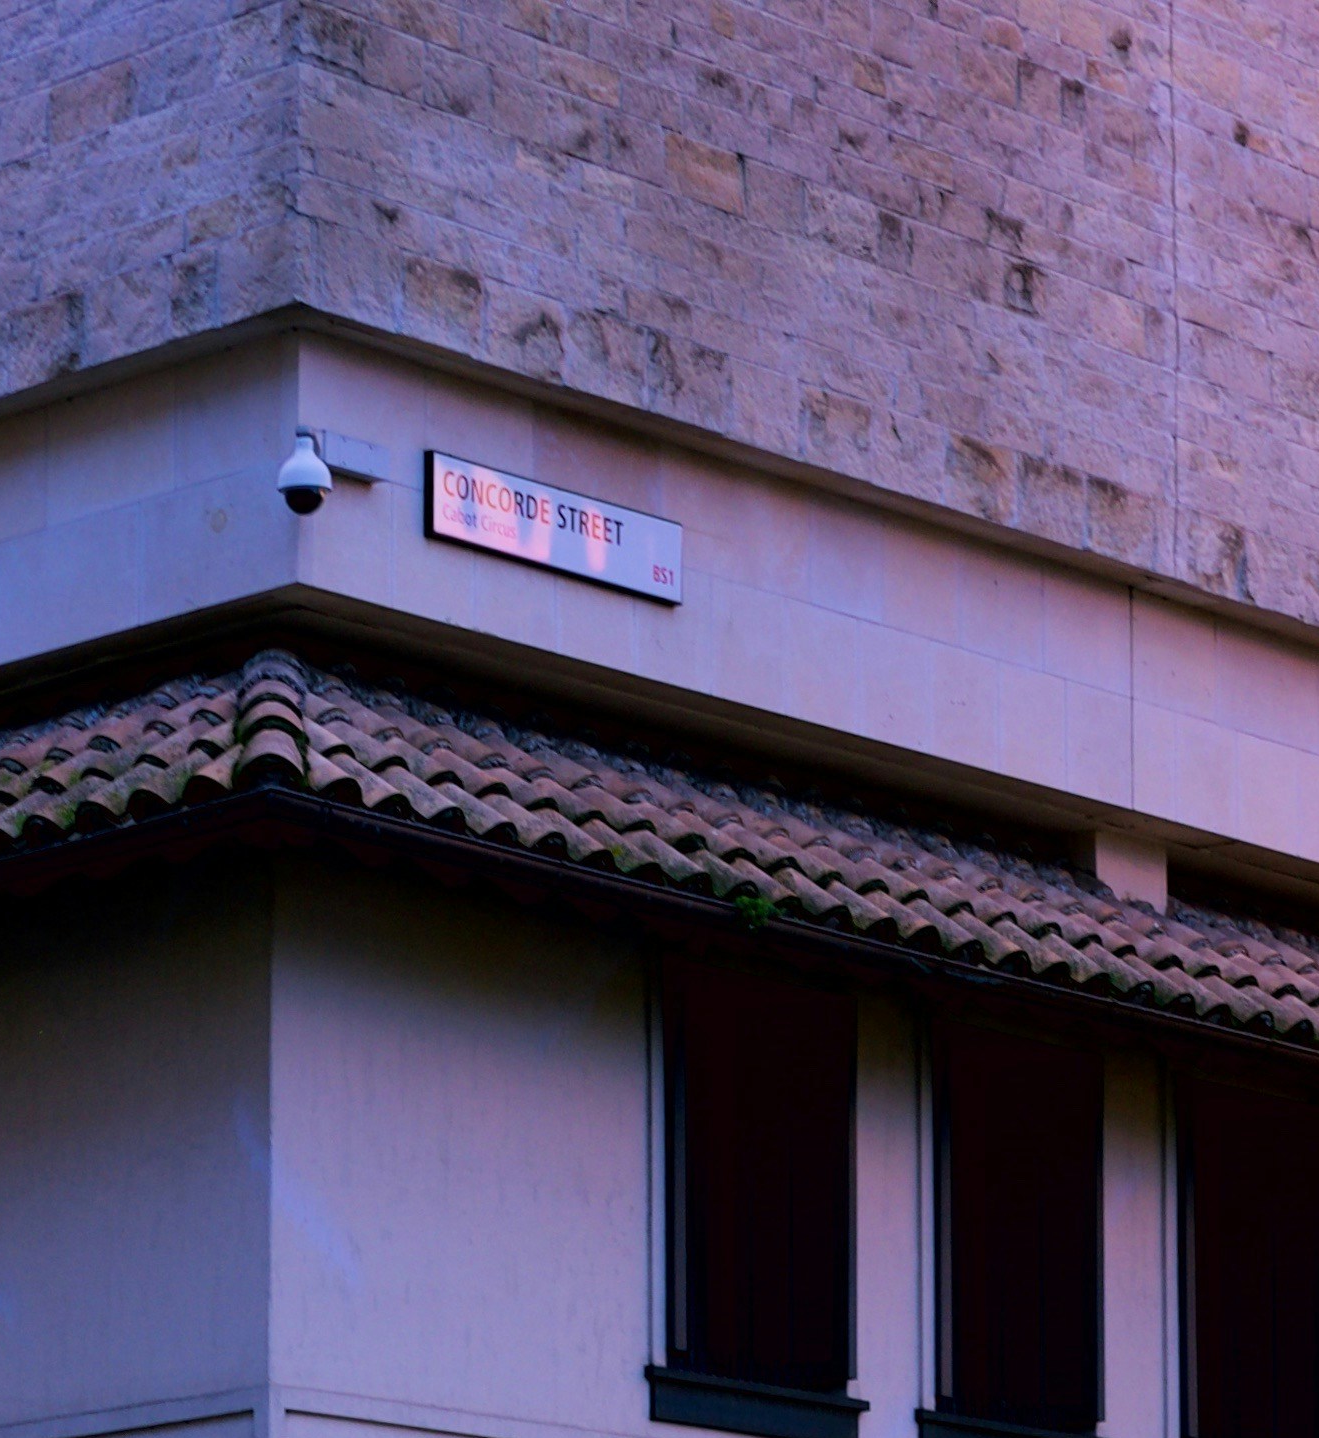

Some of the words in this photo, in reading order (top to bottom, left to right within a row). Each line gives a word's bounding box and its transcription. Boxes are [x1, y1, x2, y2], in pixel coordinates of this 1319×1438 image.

[442, 502, 477, 529] Cabot
[481, 515, 517, 540] Circus
[443, 471, 550, 524] CONCORDE
[557, 504, 624, 546] STREET
[652, 564, 674, 586] BS1
